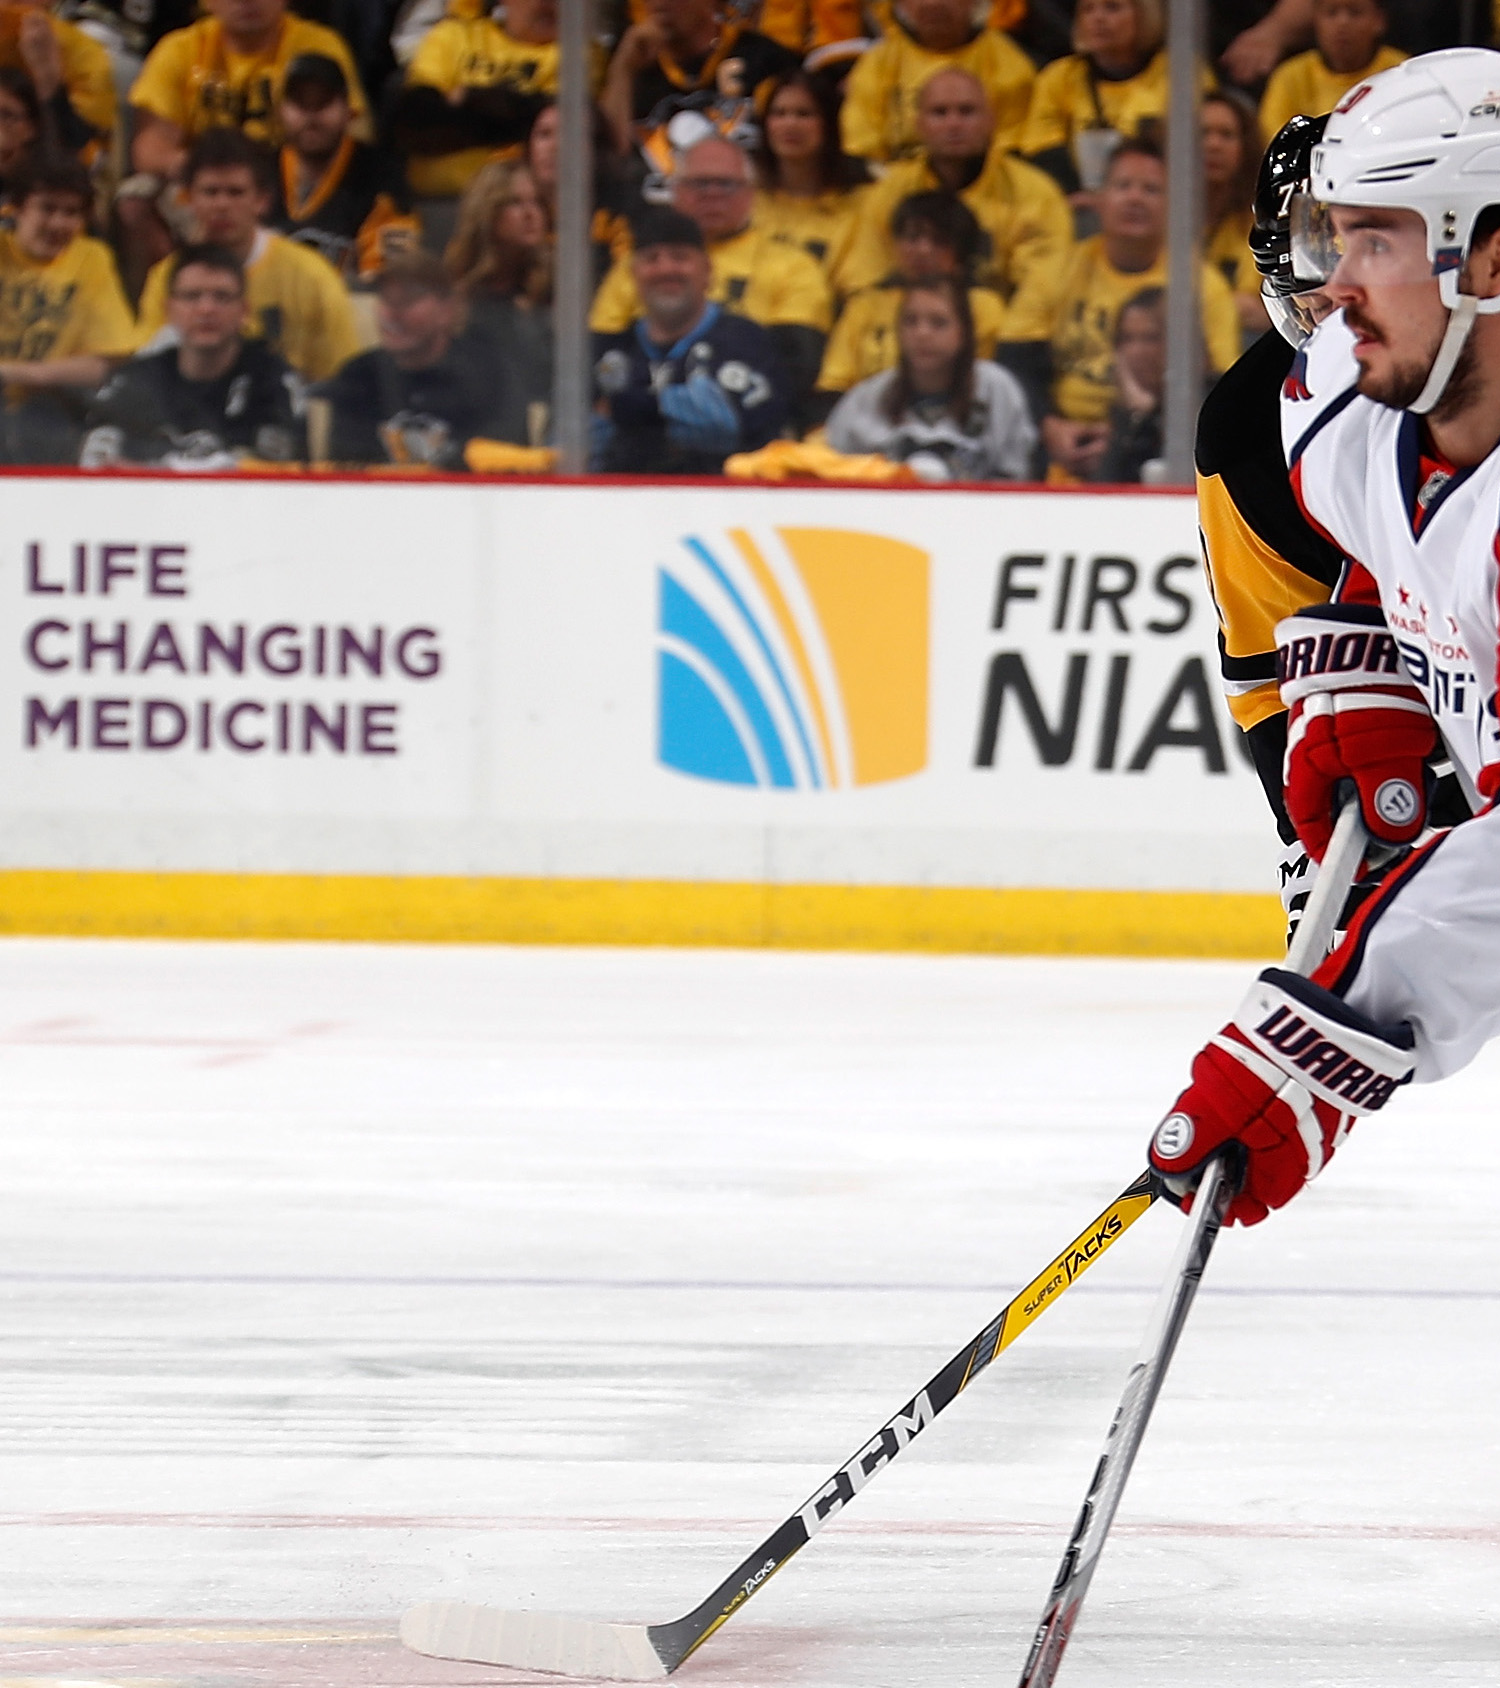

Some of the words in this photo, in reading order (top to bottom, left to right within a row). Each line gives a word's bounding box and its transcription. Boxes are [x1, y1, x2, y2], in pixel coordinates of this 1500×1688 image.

[26, 542, 190, 597] LIFE
[24, 620, 442, 679] CHANGING
[24, 696, 401, 754] MEDICINE
[1022, 1273, 1063, 1317] SUPER
[1056, 1212, 1123, 1286] TACKS
[795, 1388, 936, 1538] CCM
[740, 1557, 777, 1596] TACKS
